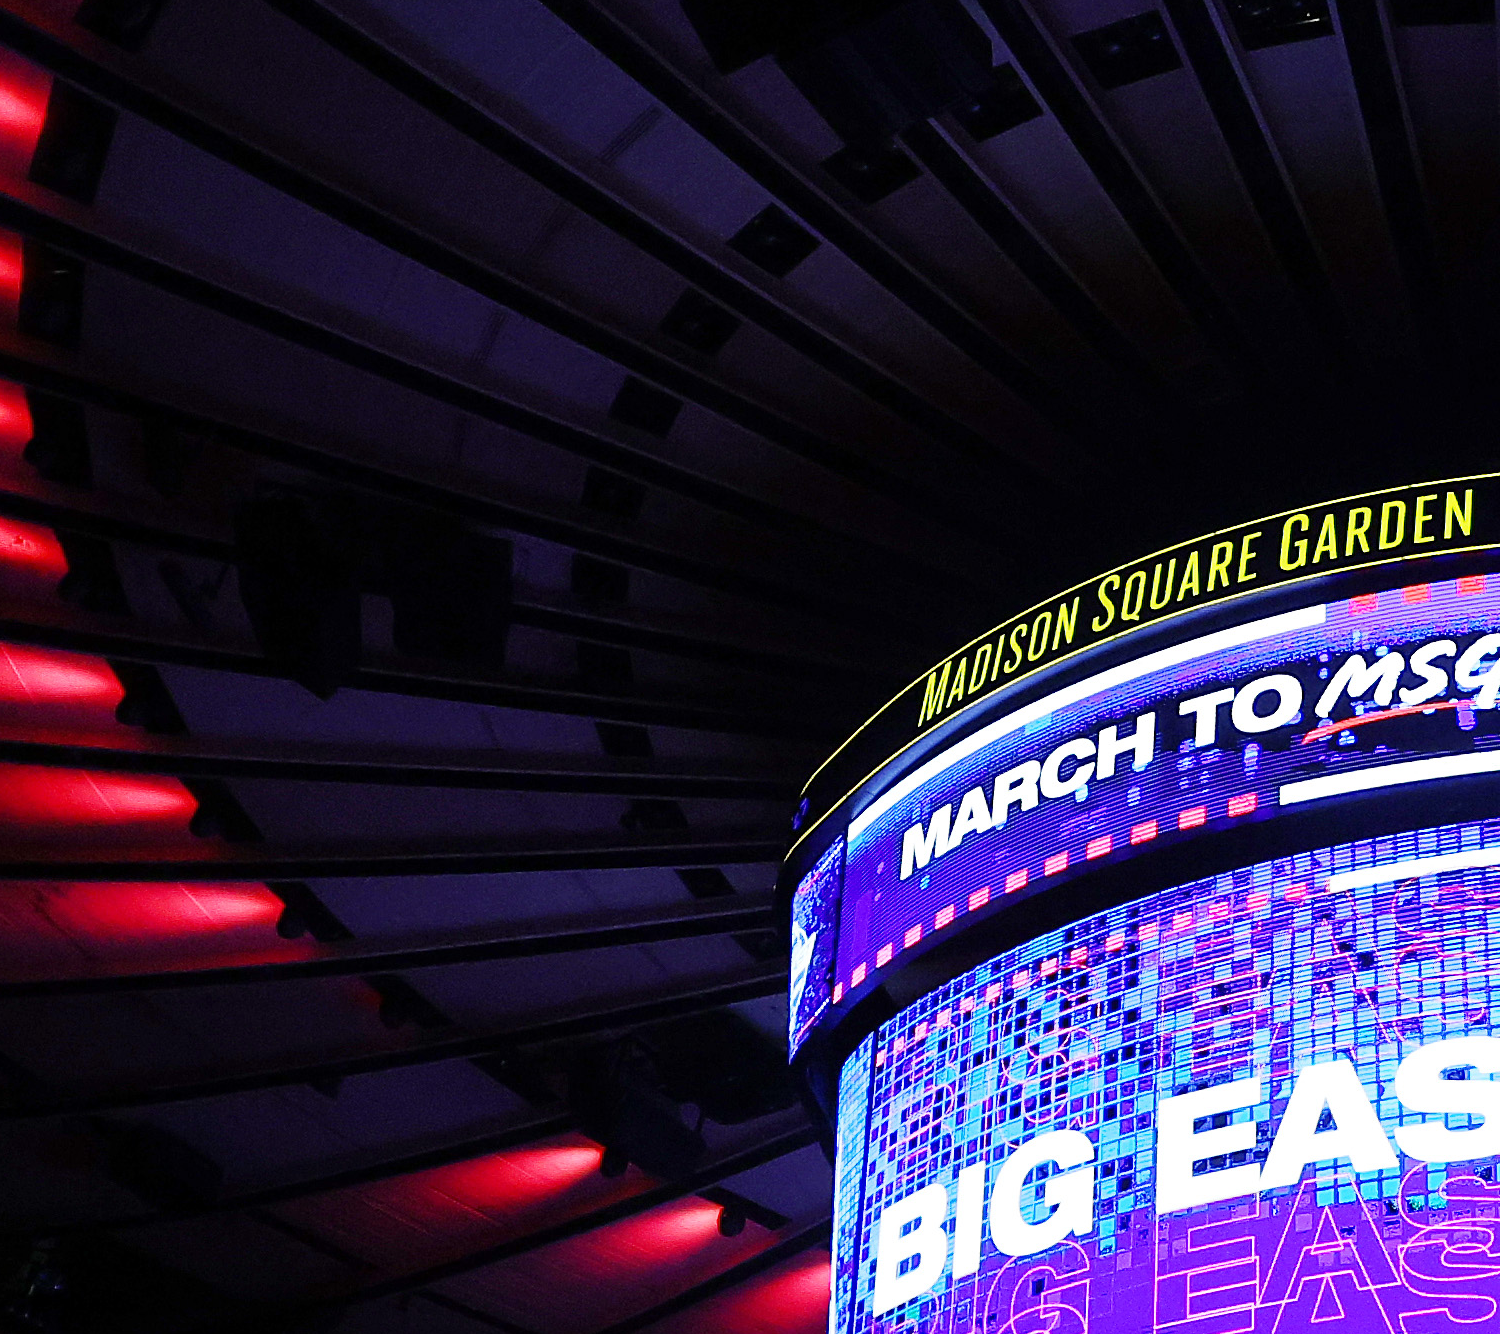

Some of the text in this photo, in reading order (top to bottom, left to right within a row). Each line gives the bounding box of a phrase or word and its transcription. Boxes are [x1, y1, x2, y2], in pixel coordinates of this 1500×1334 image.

[917, 488, 1475, 728] MADISON SQUARE GARDEN
[900, 717, 1156, 881] MARCH
[1179, 674, 1302, 748] TO
[871, 1128, 1097, 1317] BIG
